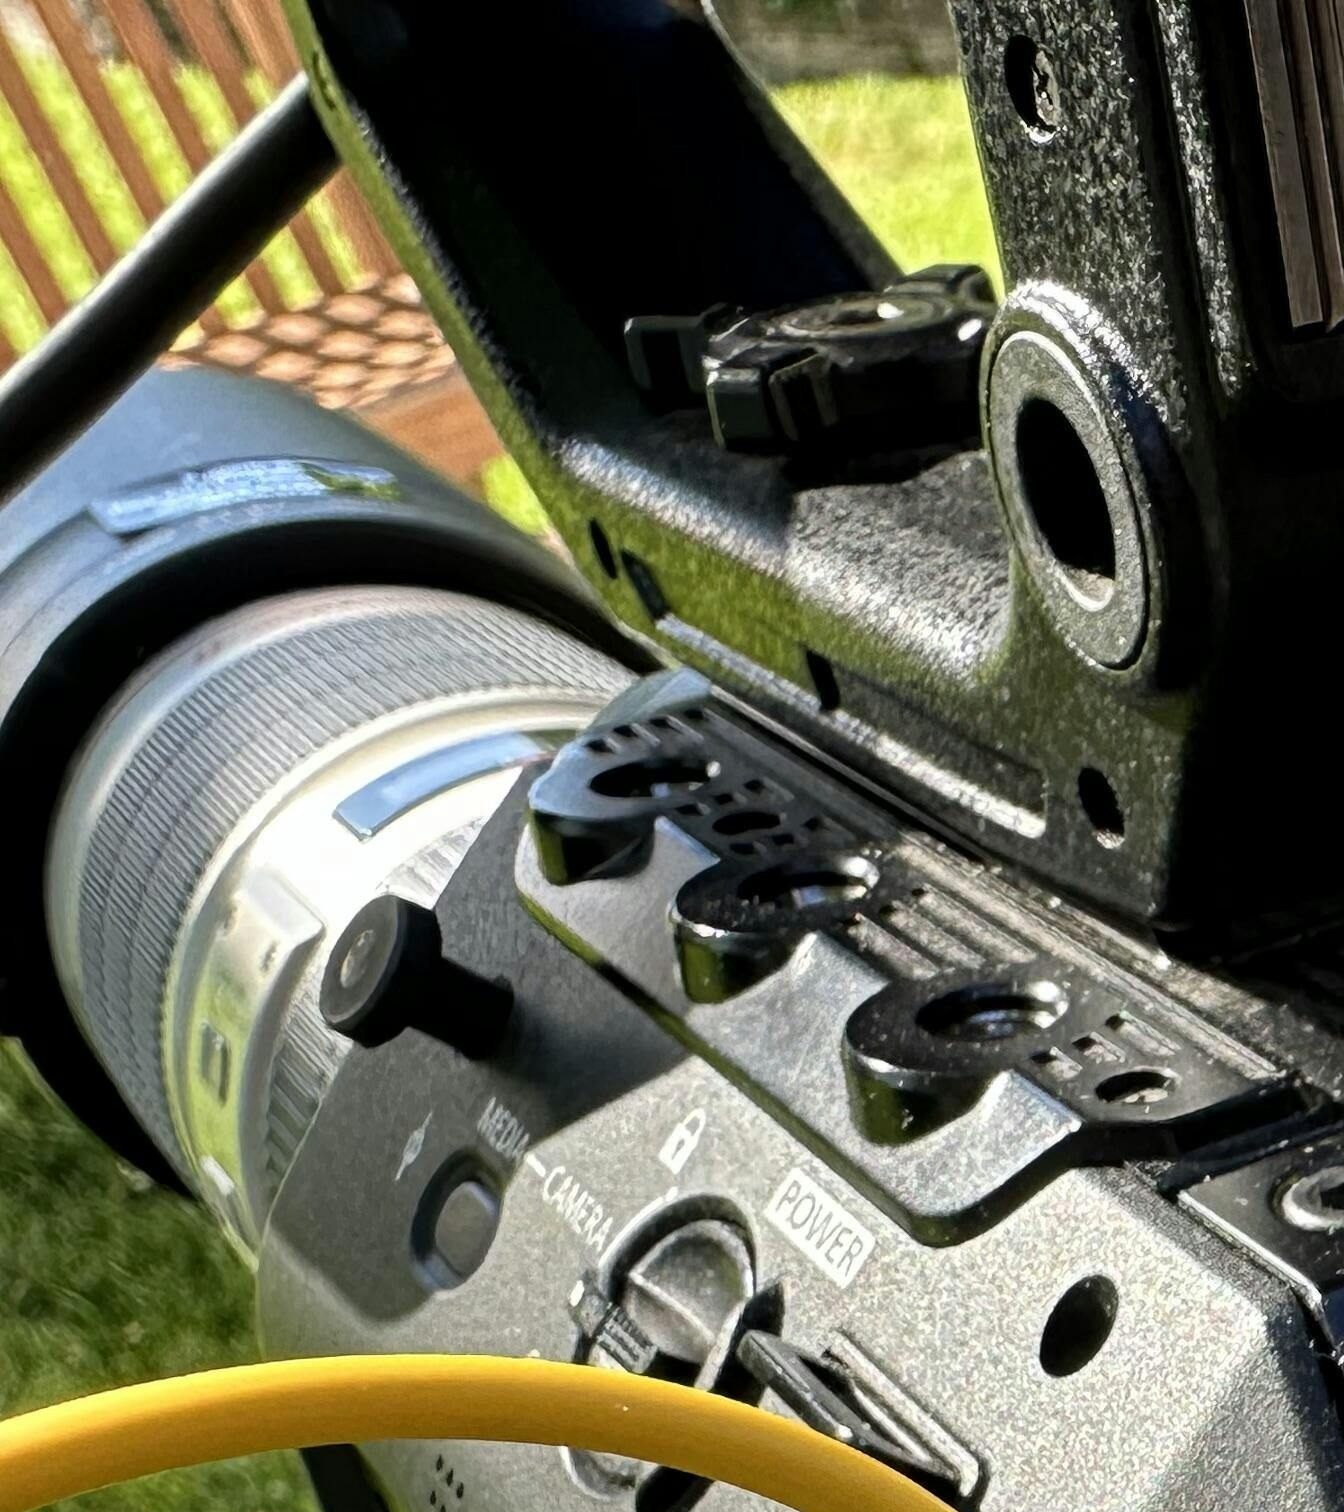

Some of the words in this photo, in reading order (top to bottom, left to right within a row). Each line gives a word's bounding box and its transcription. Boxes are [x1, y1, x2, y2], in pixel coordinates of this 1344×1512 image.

[476, 1096, 532, 1162] MEDIA
[543, 1165, 614, 1252] CAMERA
[776, 1179, 865, 1278] POWER
